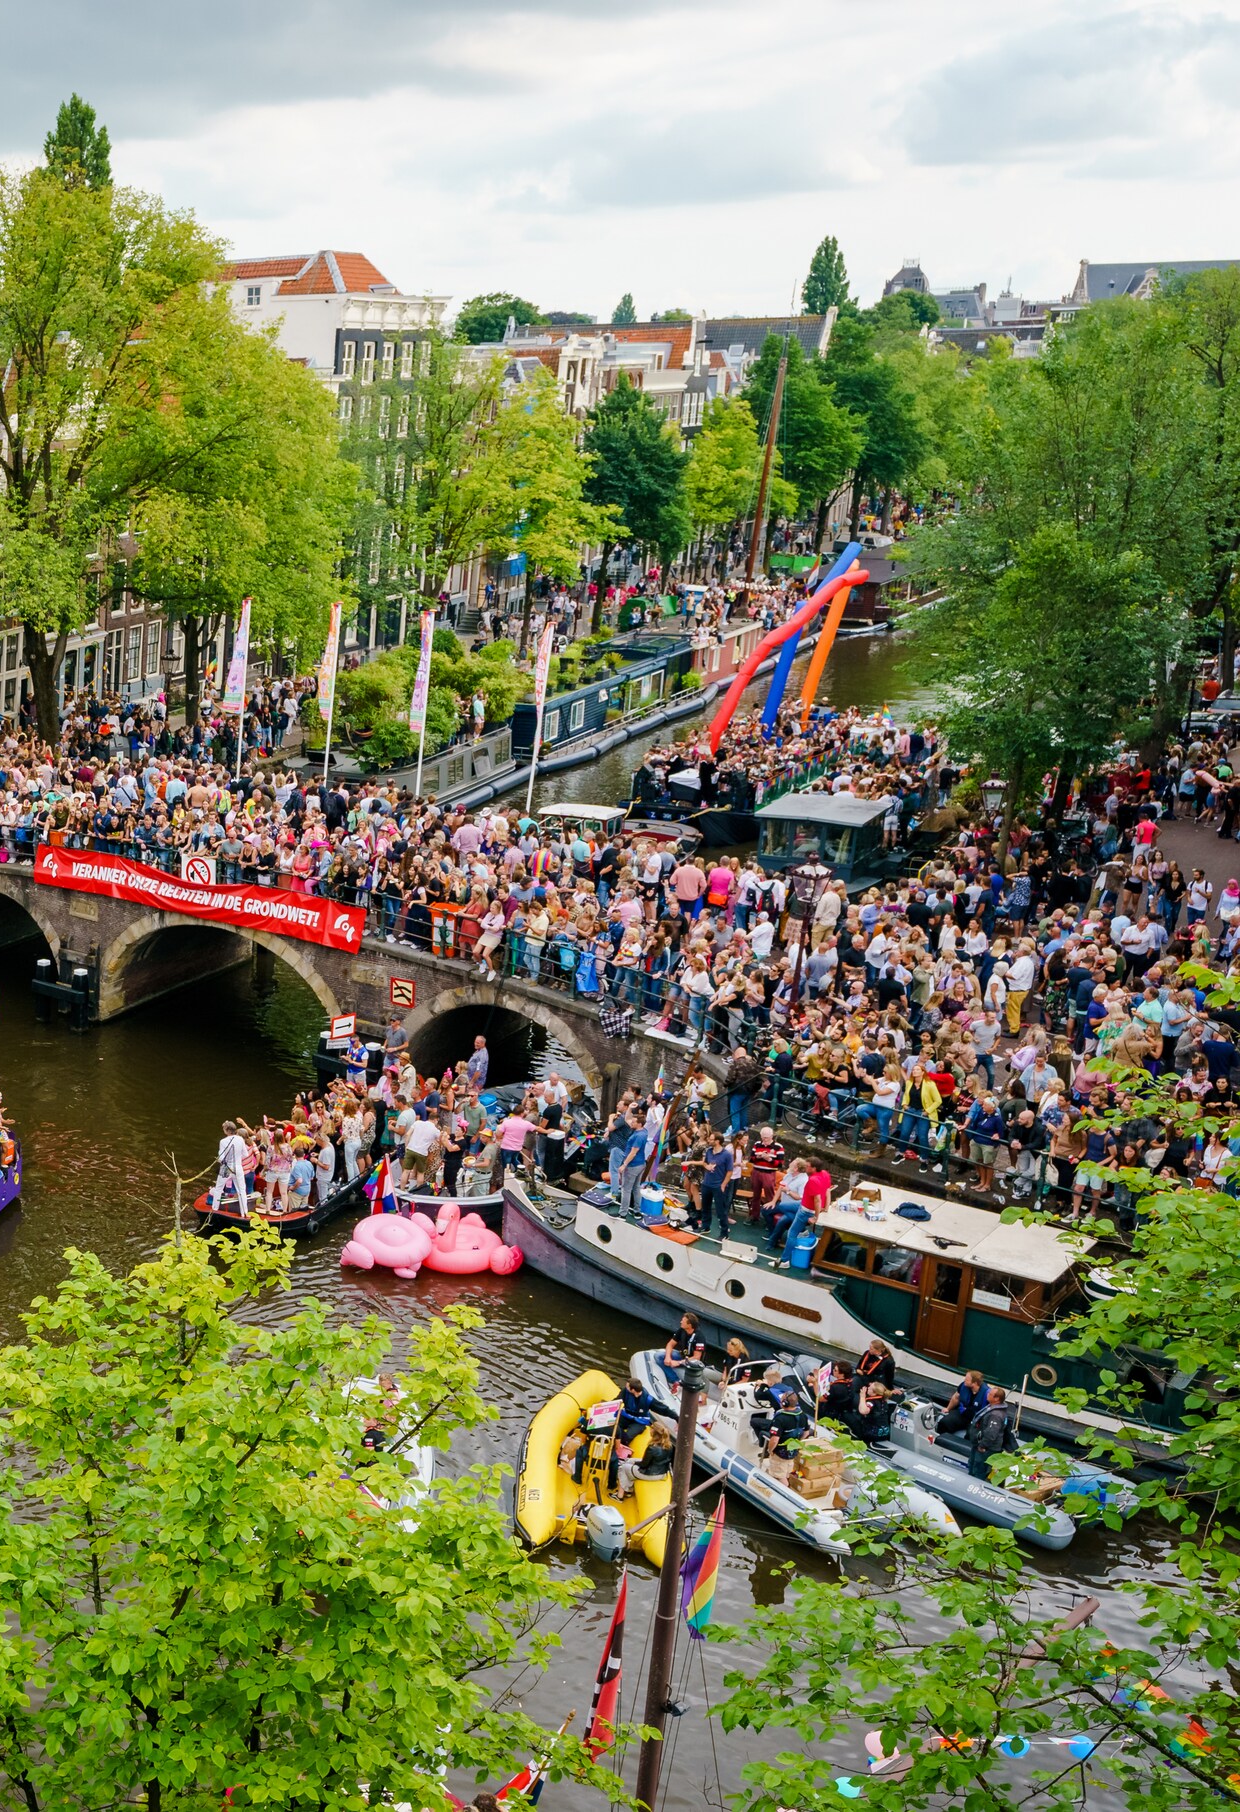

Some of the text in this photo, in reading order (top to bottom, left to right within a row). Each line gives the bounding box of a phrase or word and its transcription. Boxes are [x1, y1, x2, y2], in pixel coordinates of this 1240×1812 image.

[71, 862, 321, 928] VERANKER ONZE RECHTEN IN DE GRONDWET!
